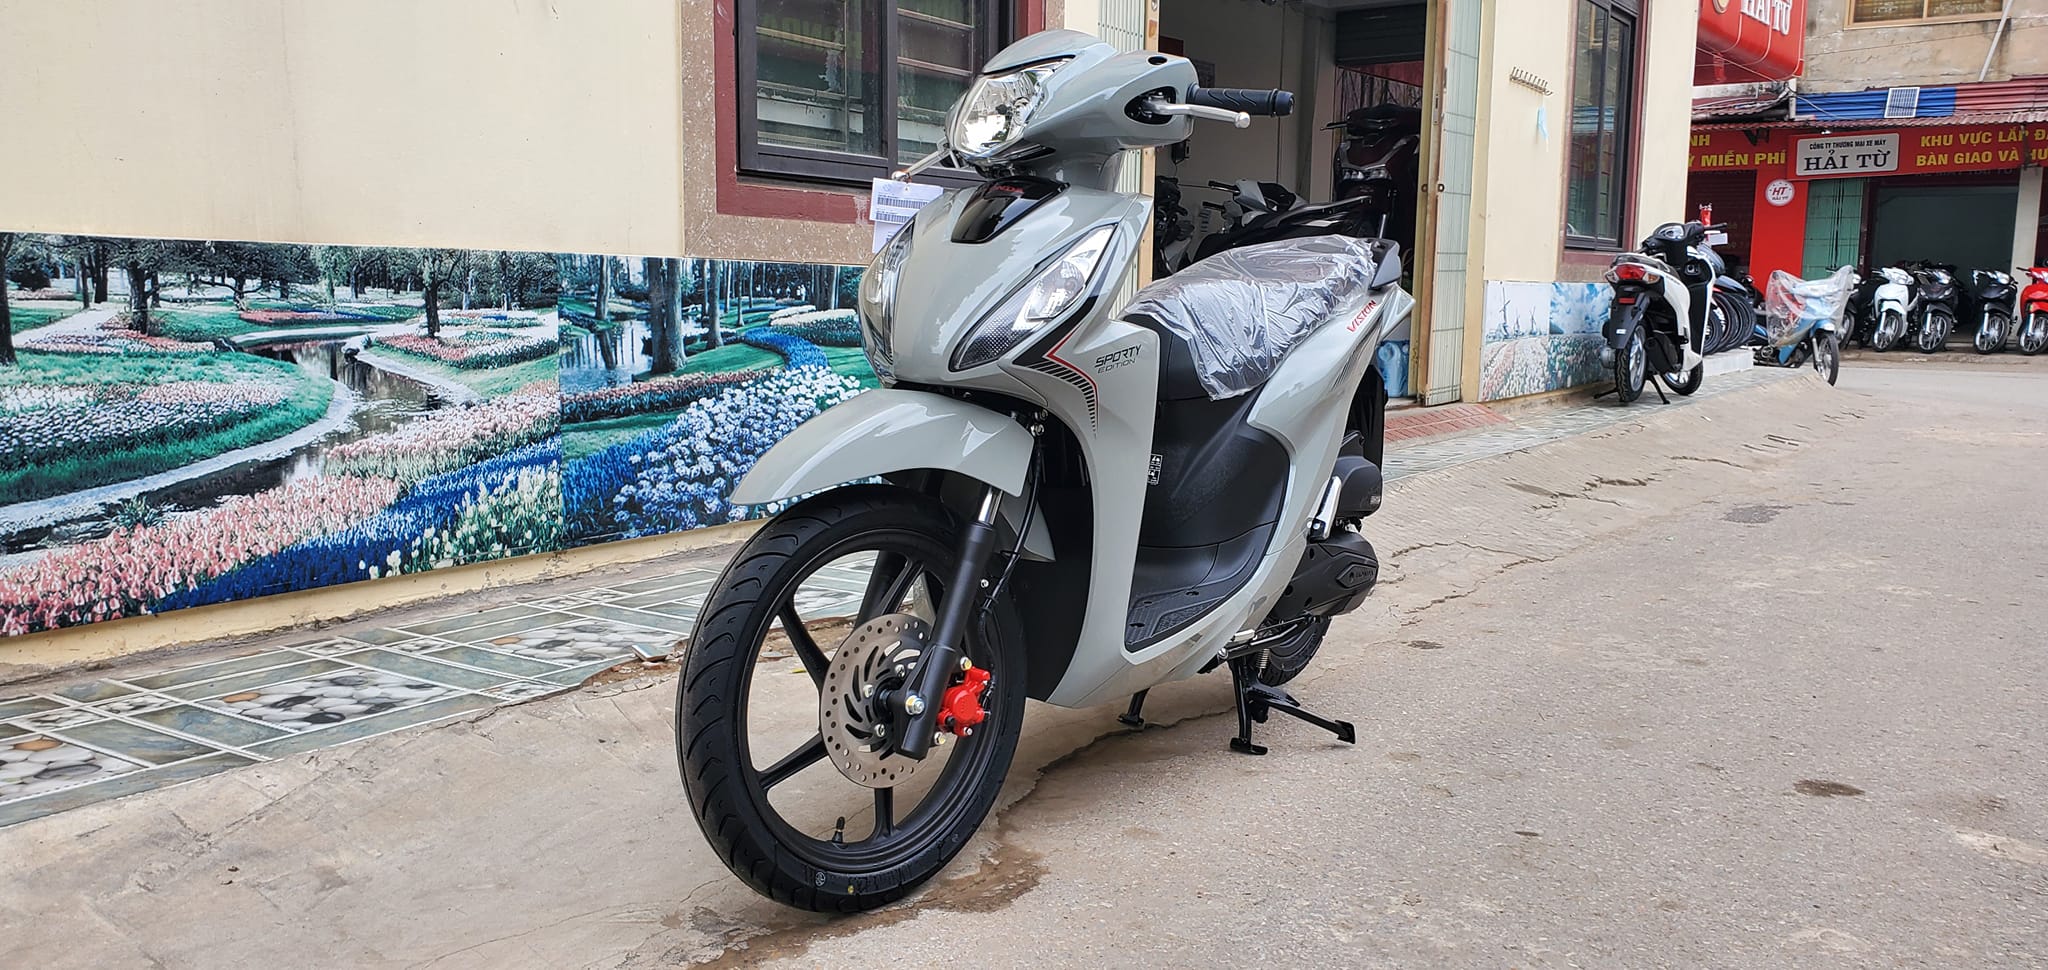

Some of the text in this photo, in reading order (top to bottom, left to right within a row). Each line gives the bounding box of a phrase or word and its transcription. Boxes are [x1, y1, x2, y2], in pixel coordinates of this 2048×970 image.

[1920, 134, 1953, 147] KHU
[1959, 131, 1992, 147] VỰC
[1701, 150, 1749, 167] MIỄN
[1754, 149, 1786, 165] PHÍ
[1804, 149, 1891, 171] HẢI TỪ
[1916, 151, 1948, 167] BÀN
[1954, 151, 1993, 164] GIAO
[1998, 147, 2019, 162] VÀ
[1772, 186, 1789, 196] HT
[1346, 299, 1377, 333] VISION
[1094, 344, 1142, 368] SPORTY
[1097, 358, 1137, 374] EDITION
